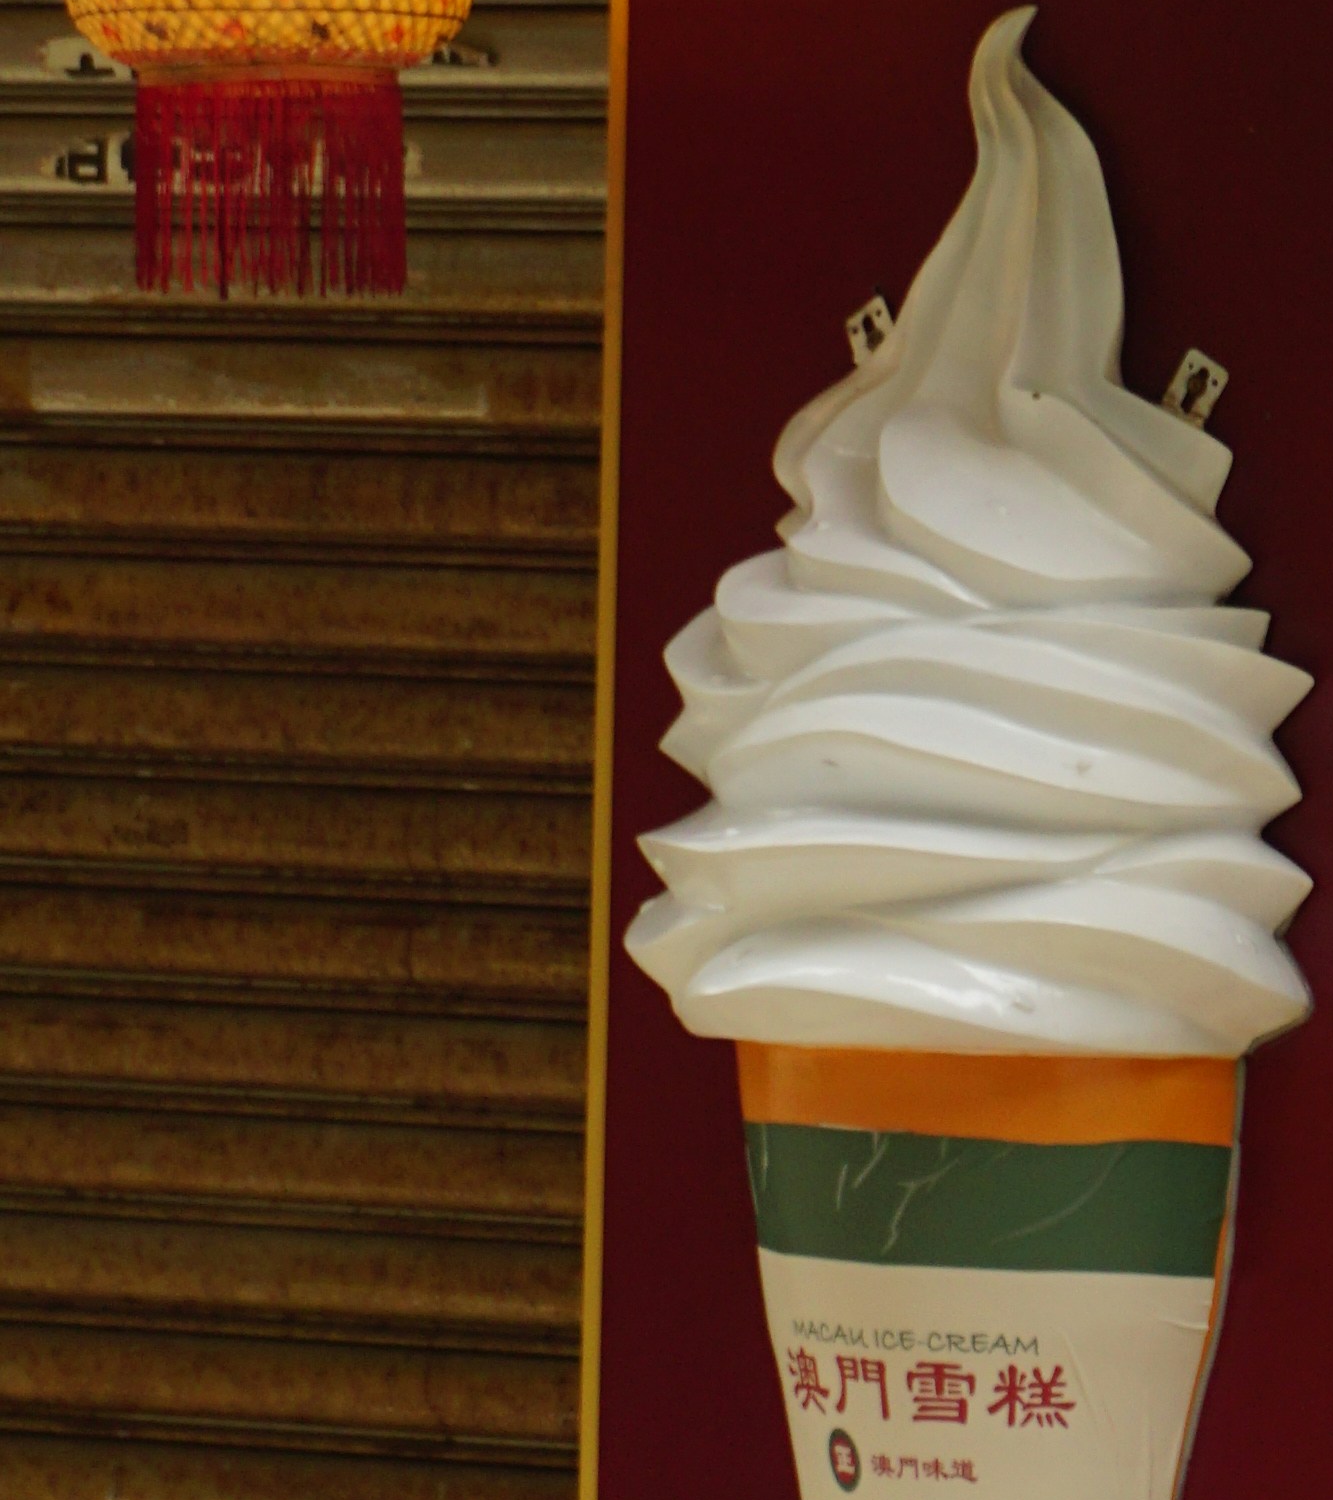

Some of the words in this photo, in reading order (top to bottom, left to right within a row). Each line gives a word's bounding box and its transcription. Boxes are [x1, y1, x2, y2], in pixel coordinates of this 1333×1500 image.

[786, 1346, 1077, 1430] 澳門雪糕
[870, 1454, 978, 1484] 澳門味道
